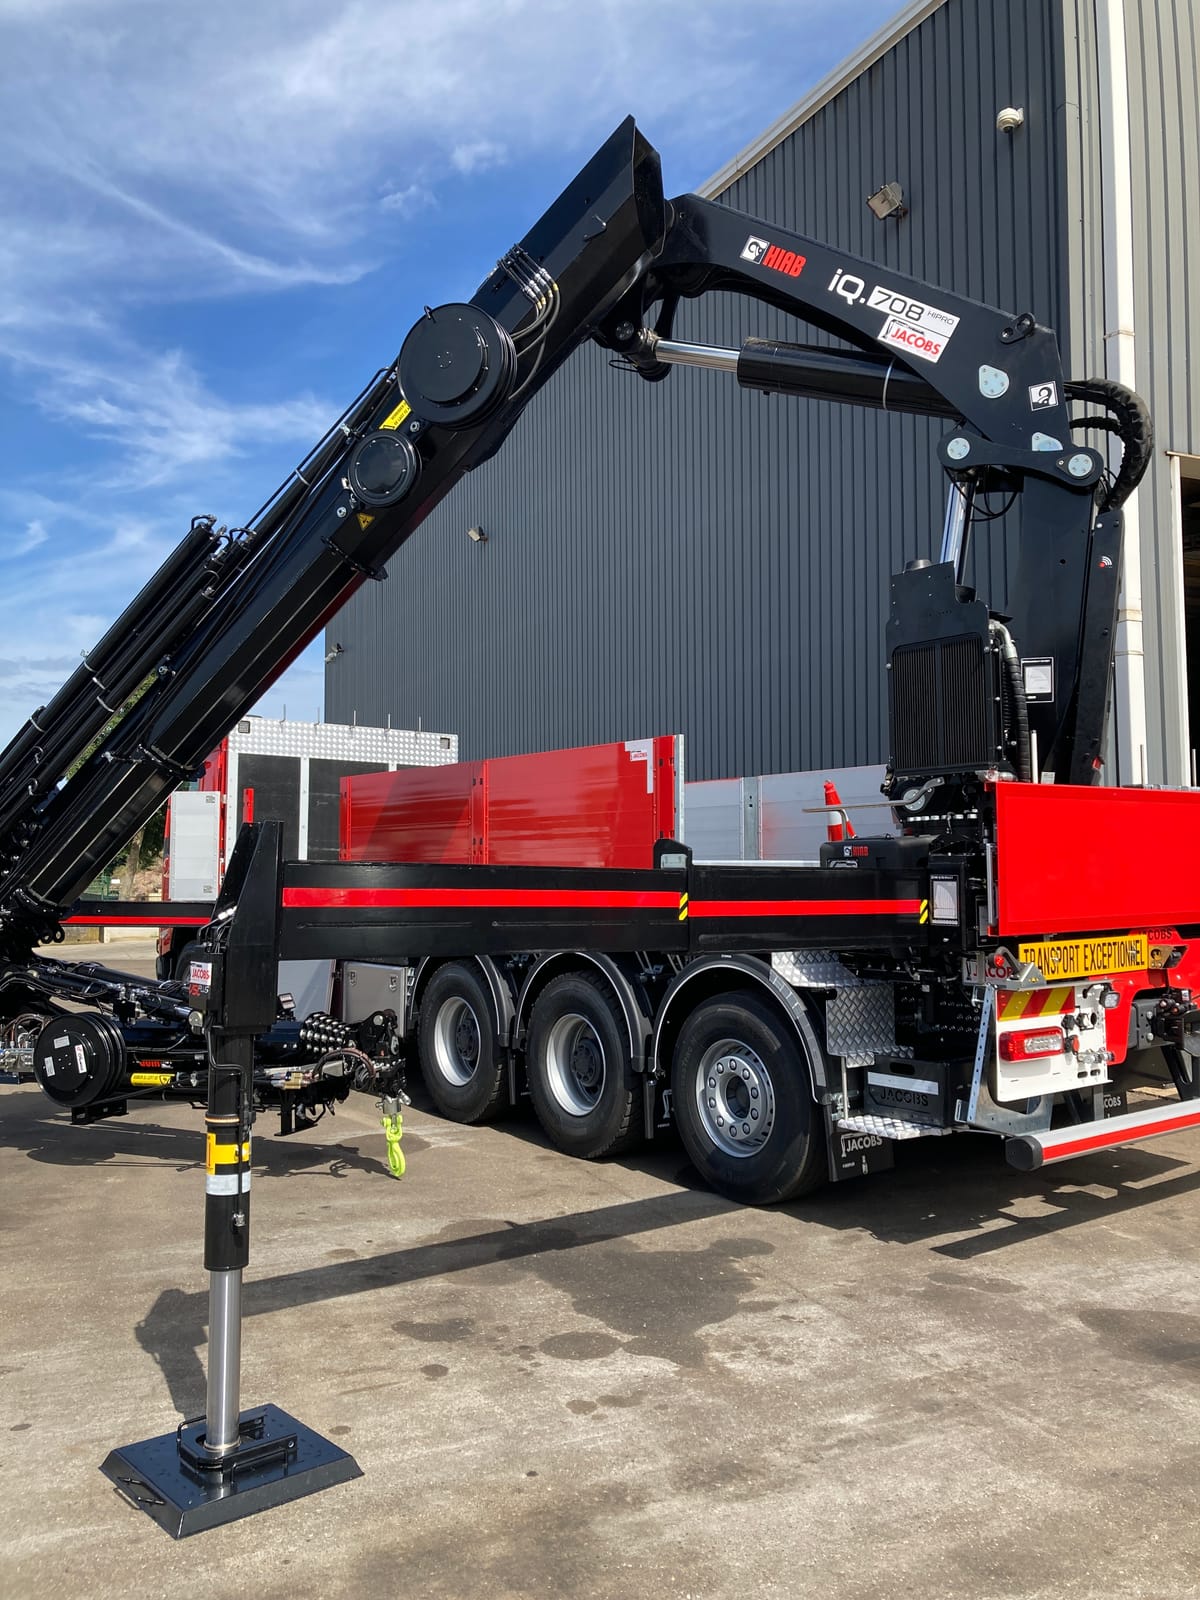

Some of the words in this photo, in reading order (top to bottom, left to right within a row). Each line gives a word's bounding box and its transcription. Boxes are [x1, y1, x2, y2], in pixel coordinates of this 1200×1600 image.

[763, 245, 807, 278] HIAB
[891, 327, 942, 355] JACOBS
[1084, 939, 1145, 972] EXCEPTIONNEL
[881, 1087, 929, 1106] JACOBS
[1103, 1096, 1121, 1109] COBS
[846, 1135, 883, 1152] JACOBS
